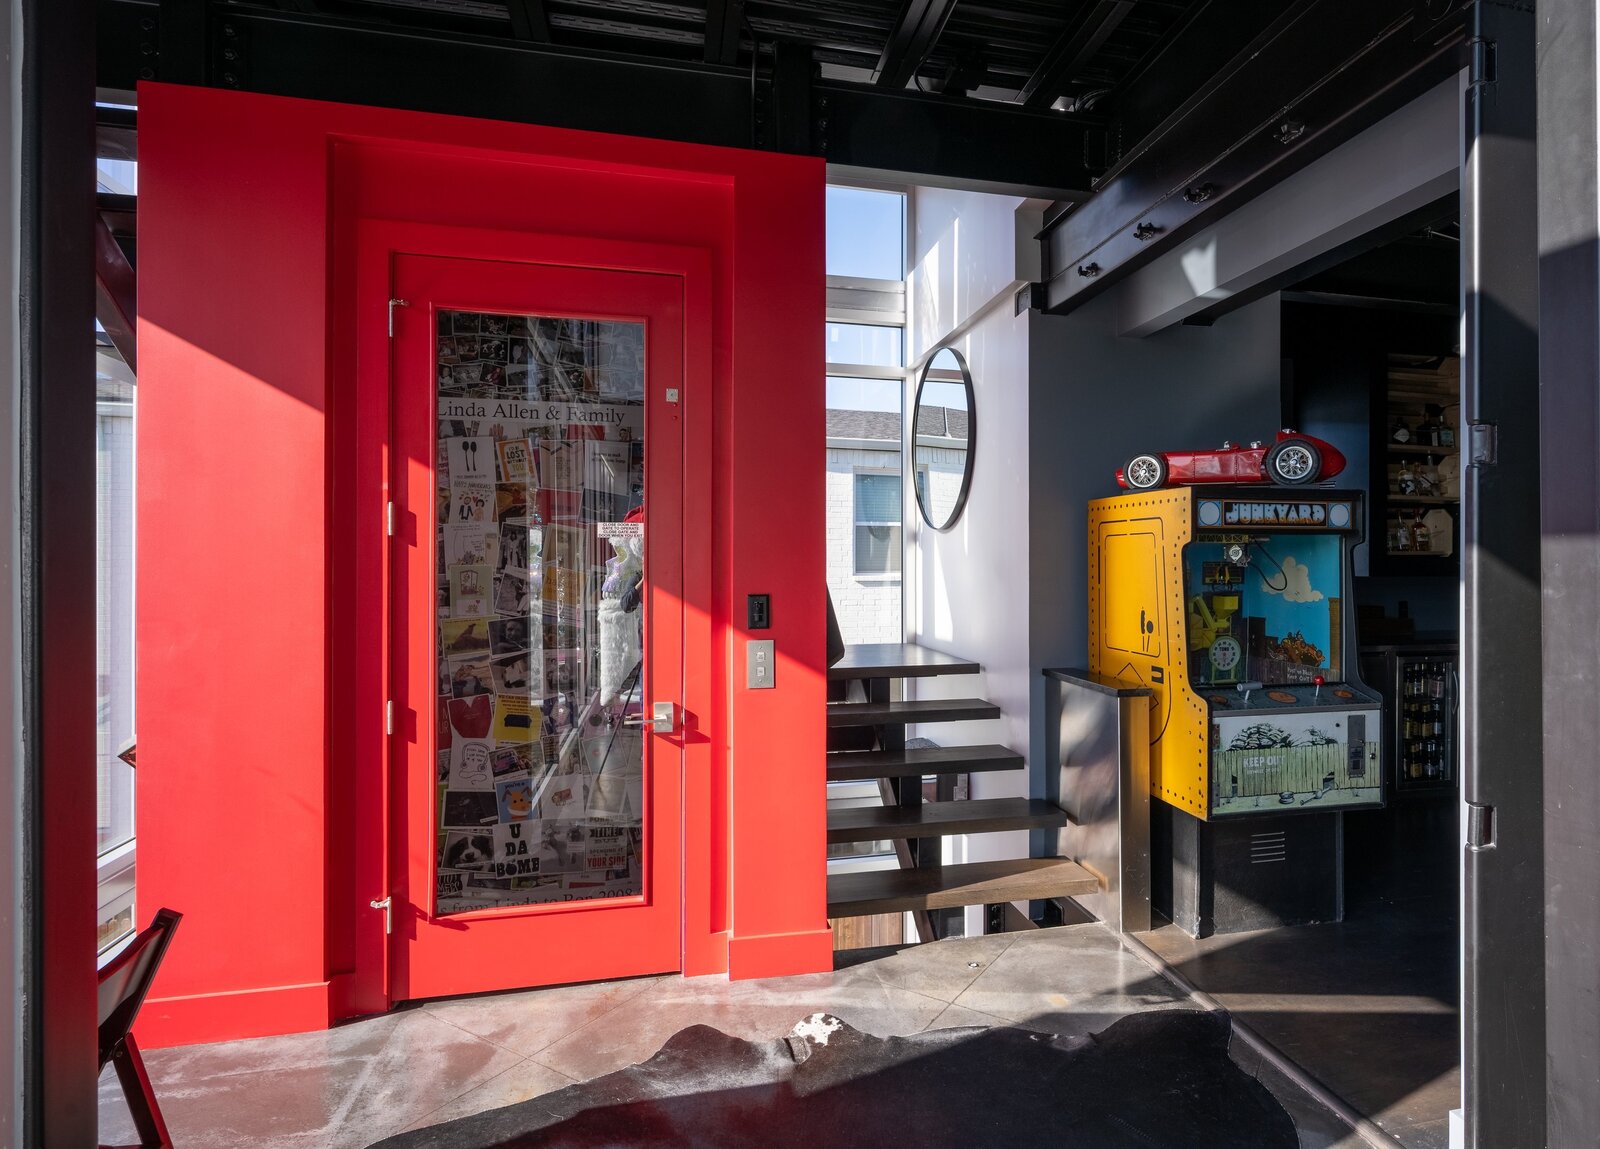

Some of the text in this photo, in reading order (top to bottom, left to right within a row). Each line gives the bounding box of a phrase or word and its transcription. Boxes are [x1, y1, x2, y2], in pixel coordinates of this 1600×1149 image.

[491, 403, 540, 420] Allen
[545, 405, 561, 420] &
[566, 406, 626, 426] Family
[506, 449, 525, 459] LOST
[1226, 503, 1325, 524] JUNKYARD
[1243, 755, 1285, 768] KEEP OUT
[509, 823, 521, 839] U
[505, 840, 528, 856] DA
[496, 857, 540, 877] BOMB
[587, 856, 625, 868] YOUR SIDE
